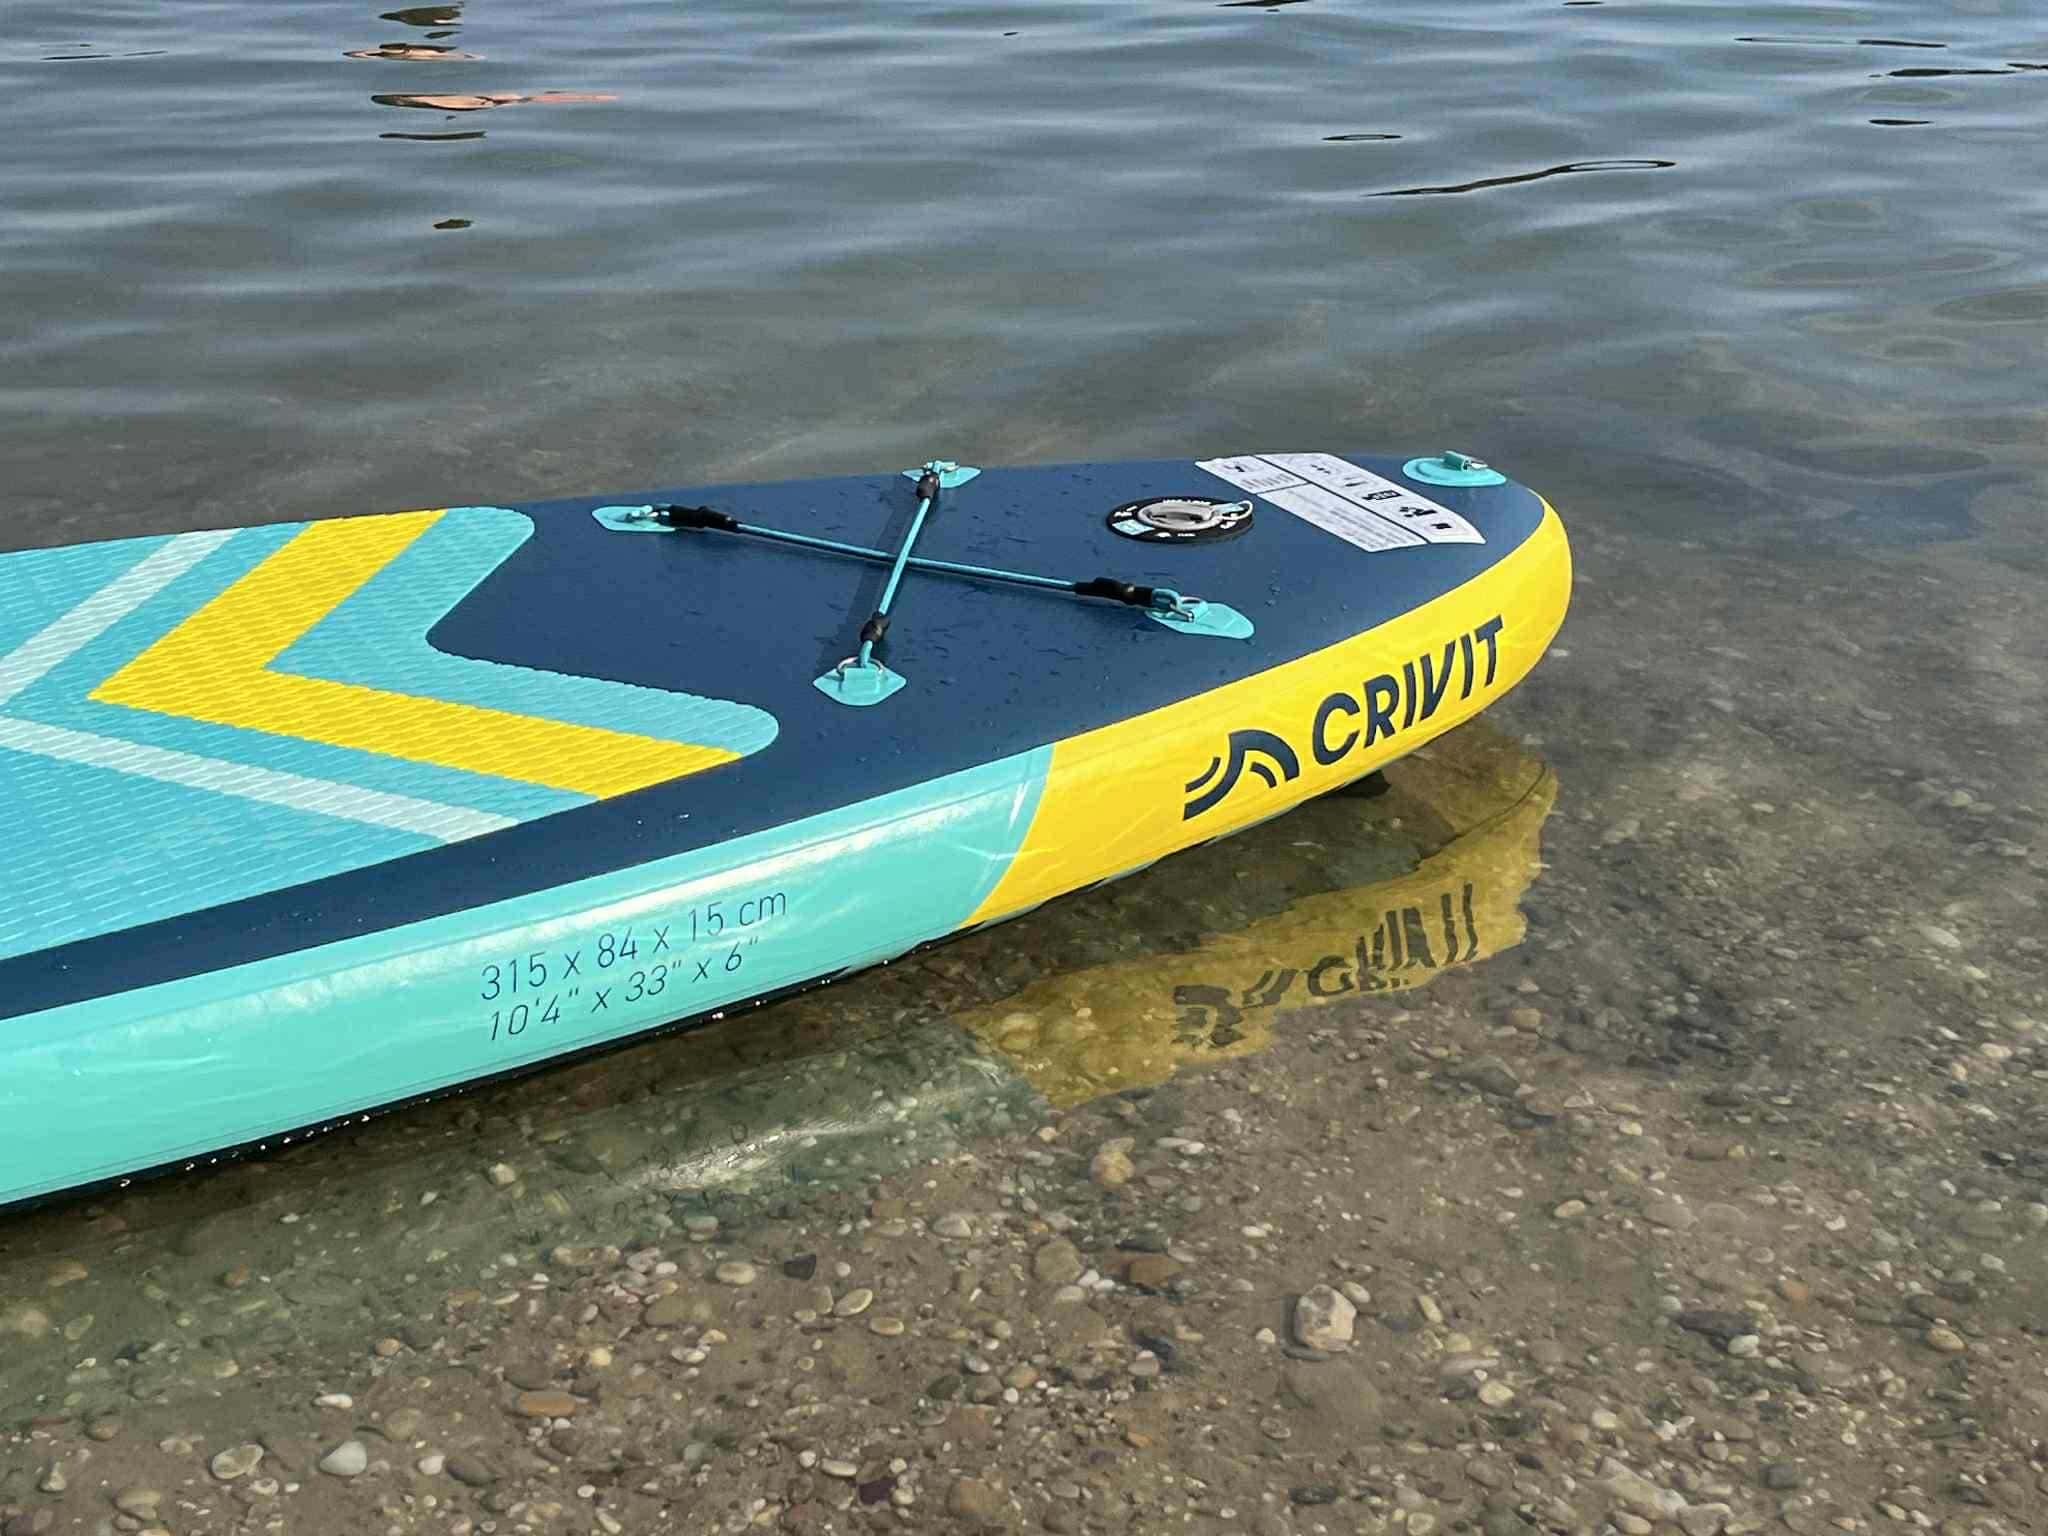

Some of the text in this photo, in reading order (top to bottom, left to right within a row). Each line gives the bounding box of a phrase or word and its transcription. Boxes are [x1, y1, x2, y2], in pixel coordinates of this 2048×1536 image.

[1311, 613, 1504, 767] CRIVIT
[481, 892, 786, 1001] 315 x 84 x 15 cm
[591, 987, 612, 1014] x
[692, 958, 712, 983] x
